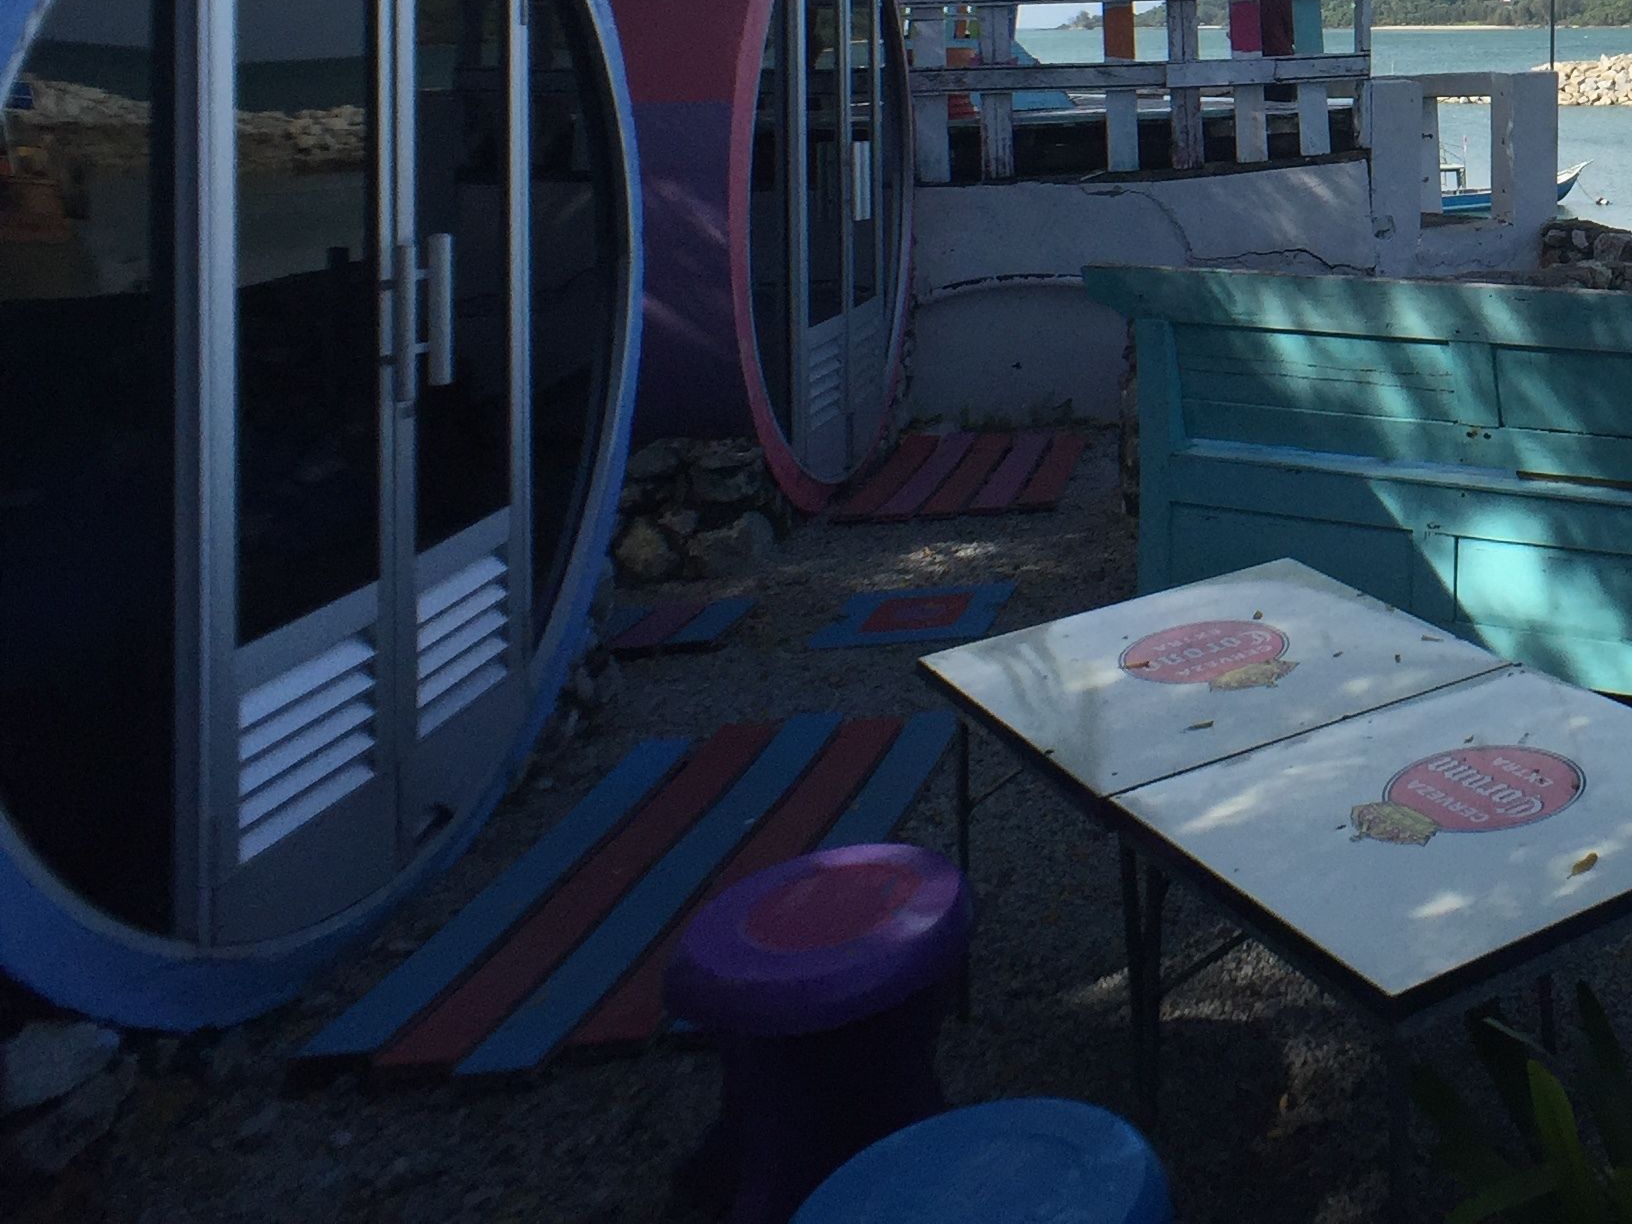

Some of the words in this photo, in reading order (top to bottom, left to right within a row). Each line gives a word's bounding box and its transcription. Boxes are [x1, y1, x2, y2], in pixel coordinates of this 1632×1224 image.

[1427, 757, 1543, 817] Corona
[1493, 758, 1553, 787] EXTRA
[1408, 779, 1488, 822] CERVEZA
